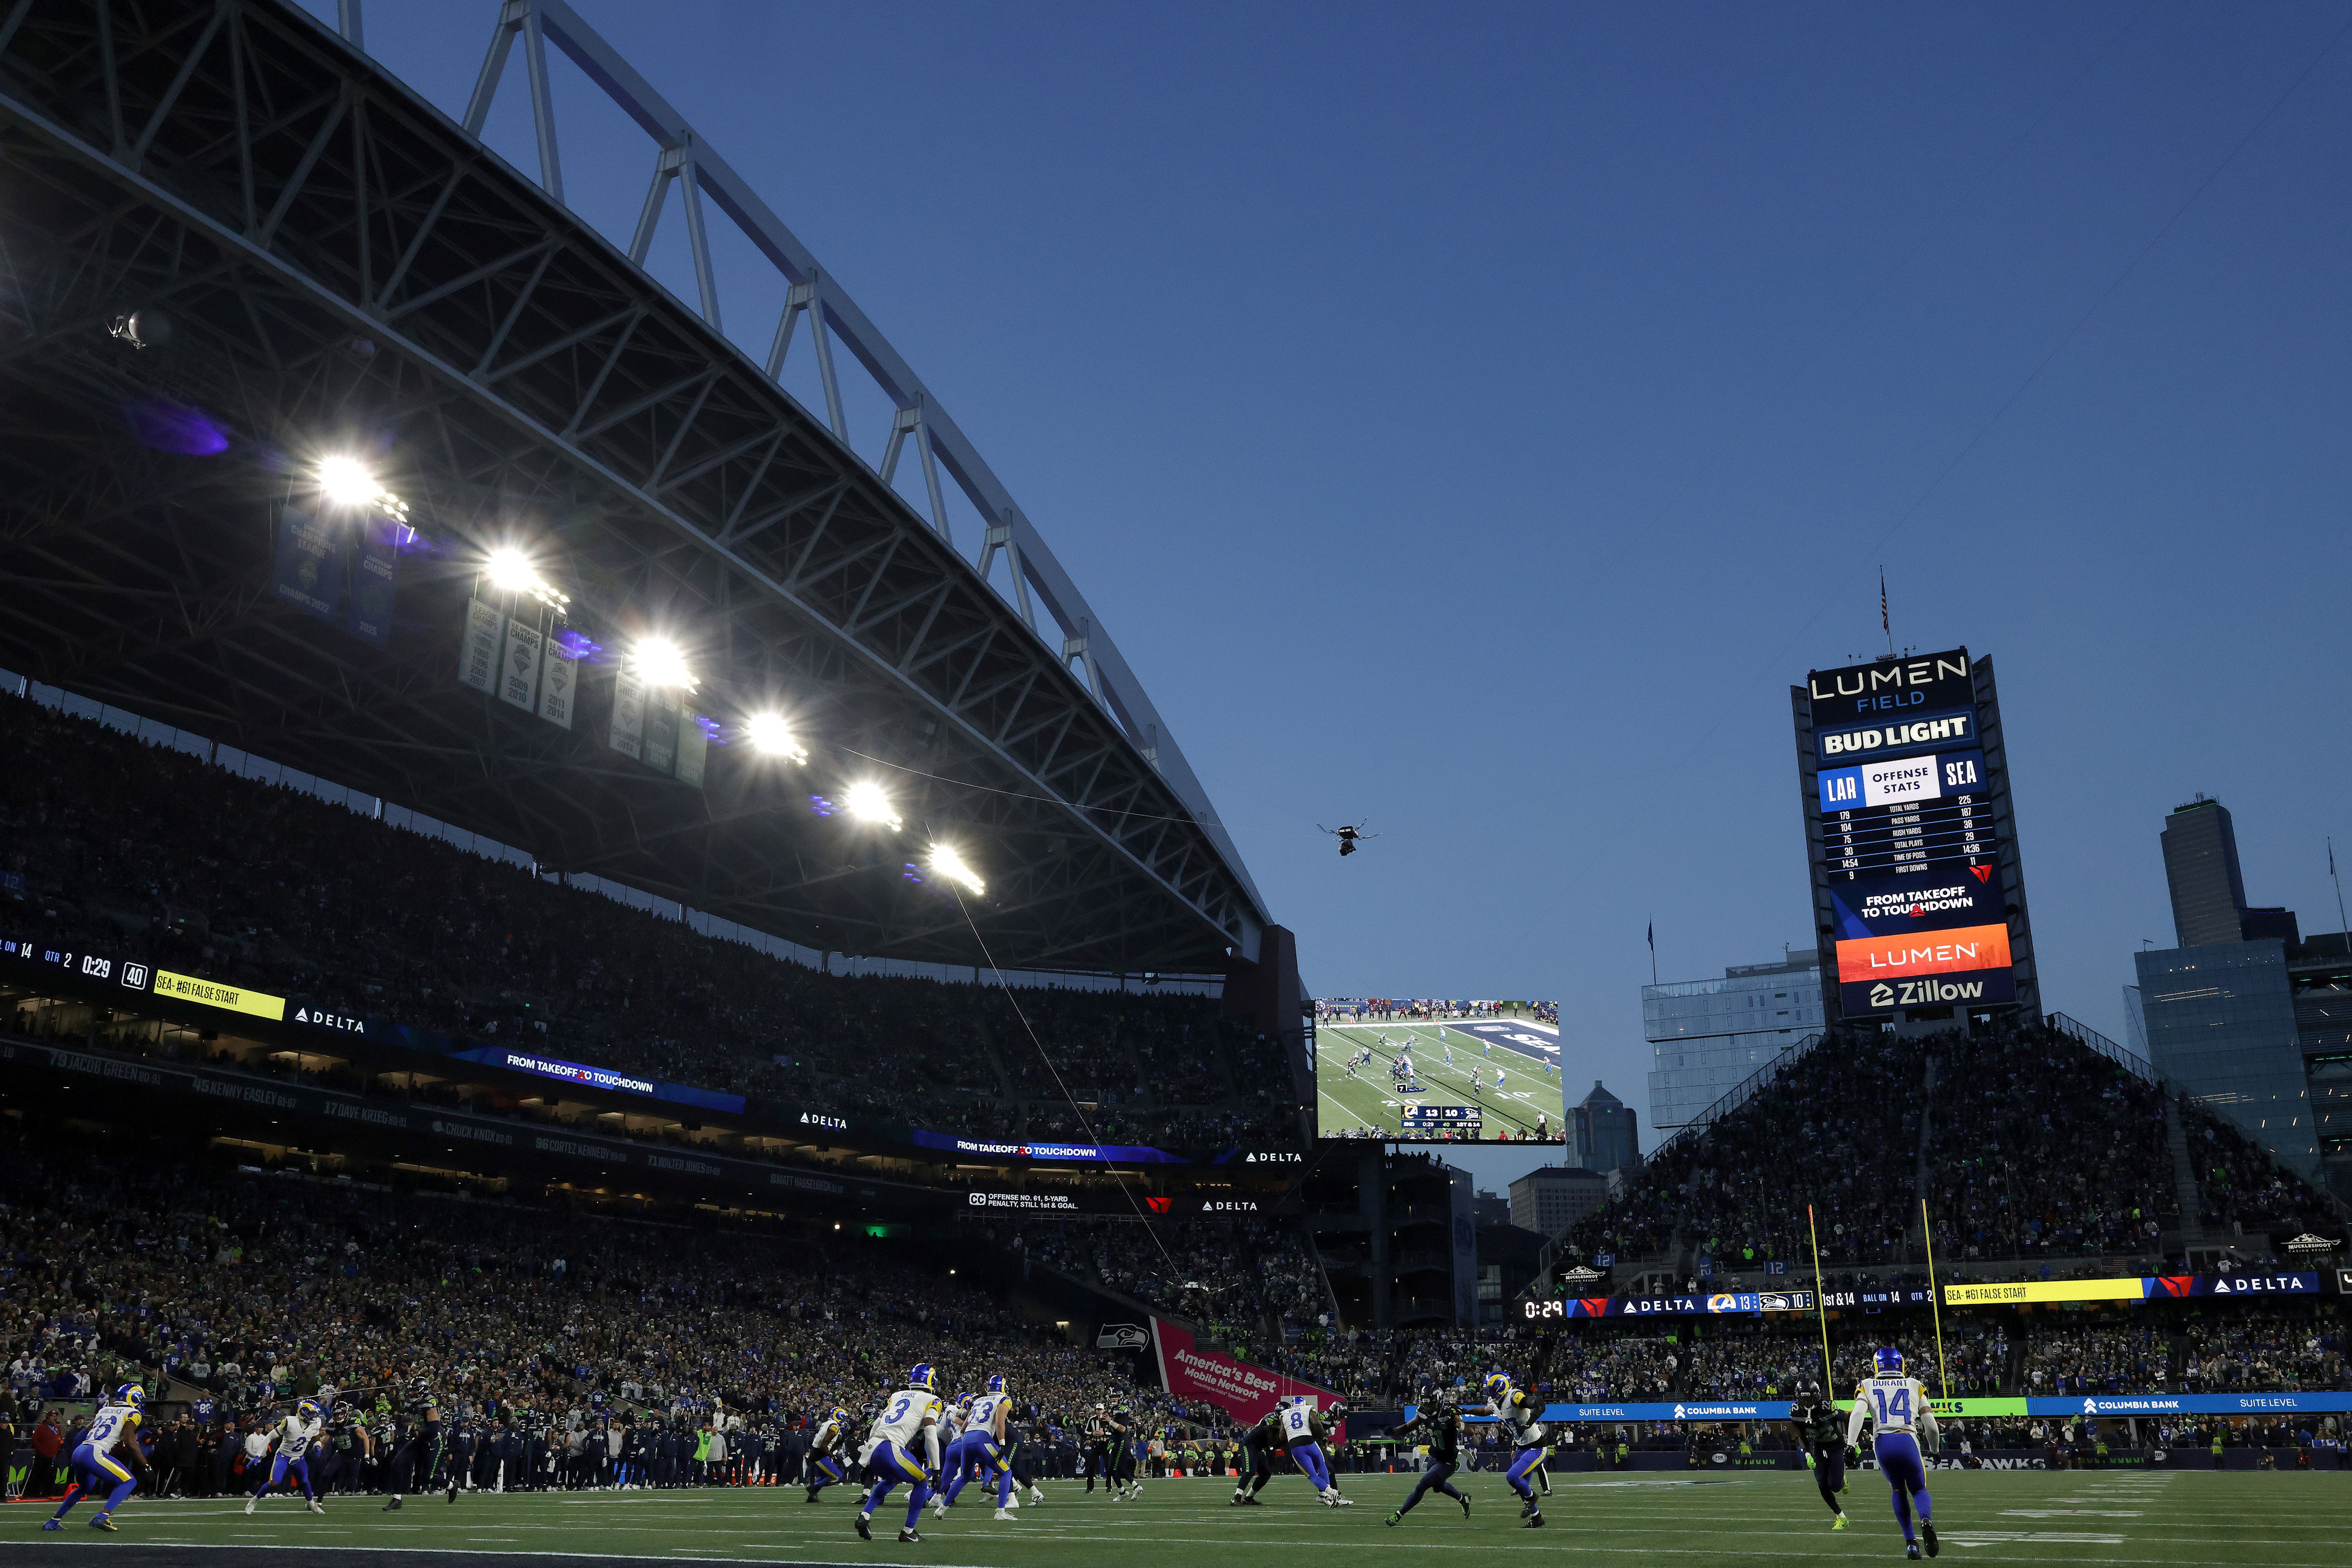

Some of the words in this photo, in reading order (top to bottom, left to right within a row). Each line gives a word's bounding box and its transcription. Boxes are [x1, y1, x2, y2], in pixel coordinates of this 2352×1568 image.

[363, 560, 393, 580] CHAMPS
[280, 583, 311, 605] CHAMPS
[473, 612, 498, 630] CHAMPS
[475, 604, 498, 620] LEAGUE
[360, 621, 377, 636] 2025
[511, 629, 539, 649] CHAMPS
[548, 647, 575, 667] CHAMPS
[469, 674, 486, 687] 2007
[510, 676, 528, 692] 2009
[1811, 656, 1966, 700] LUMEN
[508, 687, 527, 703] 2010
[548, 694, 565, 709] 2011
[617, 683, 643, 702] SHIELD
[1857, 691, 1925, 712] FIELD
[547, 705, 564, 720] 2014
[1824, 729, 1883, 754] BUD
[1886, 716, 1967, 745] LIGHT
[1872, 767, 1929, 782] OFFENSE
[1945, 760, 1977, 786] SEA
[1827, 776, 1857, 801] LAR
[1883, 781, 1920, 794] STATS
[1839, 811, 1850, 820] 179
[1889, 804, 1903, 813] TOTAL
[1903, 802, 1919, 811] YARDS
[1958, 795, 1971, 805] 225
[1840, 823, 1852, 832] 104
[1891, 816, 1904, 825] PASS
[1904, 815, 1920, 824] YARDS
[1961, 807, 1972, 816] 187
[1843, 835, 1852, 844] 75
[1892, 828, 1905, 837] RUSH
[1905, 827, 1922, 835] YARDS
[1963, 820, 1973, 829] 38
[1844, 847, 1854, 856] 30
[1894, 840, 1907, 849] TOTAL
[1908, 839, 1923, 848] PLAYS
[1965, 832, 1975, 841] 29
[1841, 858, 1858, 868] 14:54
[1893, 853, 1905, 861] TIME
[1906, 852, 1912, 860] OF
[1913, 851, 1927, 859] POSS.
[1962, 843, 1980, 854] 14:36
[1849, 871, 1854, 880] 9
[1896, 865, 1909, 873] FIRST
[1909, 863, 1928, 872] DOWNS
[1970, 857, 1976, 866] 11
[1866, 892, 1905, 906] FROM
[1906, 886, 1966, 902] TAKEOFF
[1861, 907, 1880, 918] TO
[1870, 942, 1976, 967] LUMEN
[4, 941, 16, 953] ON
[21, 942, 32, 958] 14
[45, 951, 60, 963] QTR
[63, 952, 72, 968] 2
[82, 955, 111, 978] 0:29
[126, 967, 144, 985] 40
[156, 975, 175, 990] SEA-
[176, 980, 191, 994] #61
[191, 983, 215, 1001] FALSE
[215, 989, 239, 1005] START
[313, 1010, 365, 1033] DELTA
[1897, 979, 1983, 1004] Zillow
[67, 1056, 102, 1074] JACOB
[103, 1061, 138, 1082] GREEN
[507, 1054, 535, 1069] FROM
[537, 1061, 578, 1078] TAKEOFF
[593, 1072, 653, 1093] TOUCHDOWN
[209, 1081, 244, 1100] KENNY
[243, 1087, 278, 1106] EASLEY
[324, 1101, 337, 1116] 17
[337, 1104, 360, 1119] DAVE
[361, 1108, 389, 1124] KRIEG
[811, 1114, 847, 1130] DELTA
[1445, 1109, 1458, 1117] 10
[446, 1122, 473, 1139] CHUCK
[473, 1126, 496, 1141] KNOX
[535, 1137, 549, 1151] 96
[549, 1140, 578, 1155] CORTEZ
[577, 1144, 610, 1161] KENNEDY
[957, 1140, 977, 1151] FROM
[979, 1144, 1018, 1154] TAKEOFF
[1034, 1147, 1096, 1157] TOUCHDOWN
[1259, 1152, 1302, 1163] DELTA
[648, 1155, 658, 1167] 71
[658, 1156, 685, 1170] WALTER
[685, 1160, 706, 1174] JONES
[776, 1175, 794, 1187] MATT
[794, 1177, 832, 1193] HASSELBECK
[988, 1193, 1019, 1201] OFFENSE
[988, 1200, 1019, 1208] PENALTY,
[1216, 1202, 1258, 1211] DELTA
[1596, 1254, 1610, 1268] 12
[1769, 1262, 1784, 1276] 12
[2235, 1277, 2303, 1291] DELTA
[1641, 1298, 1695, 1311] DELTA
[1739, 1296, 1750, 1310] 13
[1792, 1293, 1803, 1307] 10
[1821, 1293, 1835, 1307] 1st
[1836, 1293, 1844, 1306] &
[1844, 1291, 1855, 1306] 14
[1863, 1293, 1878, 1302] BALL
[1878, 1293, 1887, 1302] ON
[1890, 1291, 1900, 1303] 14
[1911, 1292, 1923, 1301] QTR
[1927, 1290, 1933, 1302] 2
[1947, 1289, 1964, 1301] SEA-
[1966, 1288, 1978, 1300] #61
[1980, 1287, 2002, 1300] FALSE
[2003, 1287, 2027, 1298] START
[1525, 1300, 1563, 1319] 0:29
[1174, 1348, 1243, 1382] America's
[1243, 1371, 1277, 1394] Best
[1184, 1366, 1217, 1385] Mobile
[1217, 1378, 1260, 1401] Network
[1193, 1380, 1211, 1391] According
[1872, 1378, 1907, 1387] DURANT
[29, 1400, 39, 1410] 21
[885, 1399, 910, 1424] 3
[967, 1401, 993, 1424] 53
[1579, 1408, 1600, 1416] SUITE
[1602, 1408, 1624, 1416] LEVEL
[1687, 1406, 1731, 1415] COLUMBIA
[1732, 1406, 1757, 1414] BANK
[1873, 1388, 1912, 1425] 14
[2098, 1401, 2150, 1410] COLUMBIA
[2151, 1400, 2179, 1409] BANK
[2240, 1398, 2267, 1408] SUITE
[2268, 1397, 2297, 1407] LEVEL
[1291, 1412, 1303, 1430] 8
[291, 1437, 307, 1452] 2
[532, 1430, 546, 1441] 74
